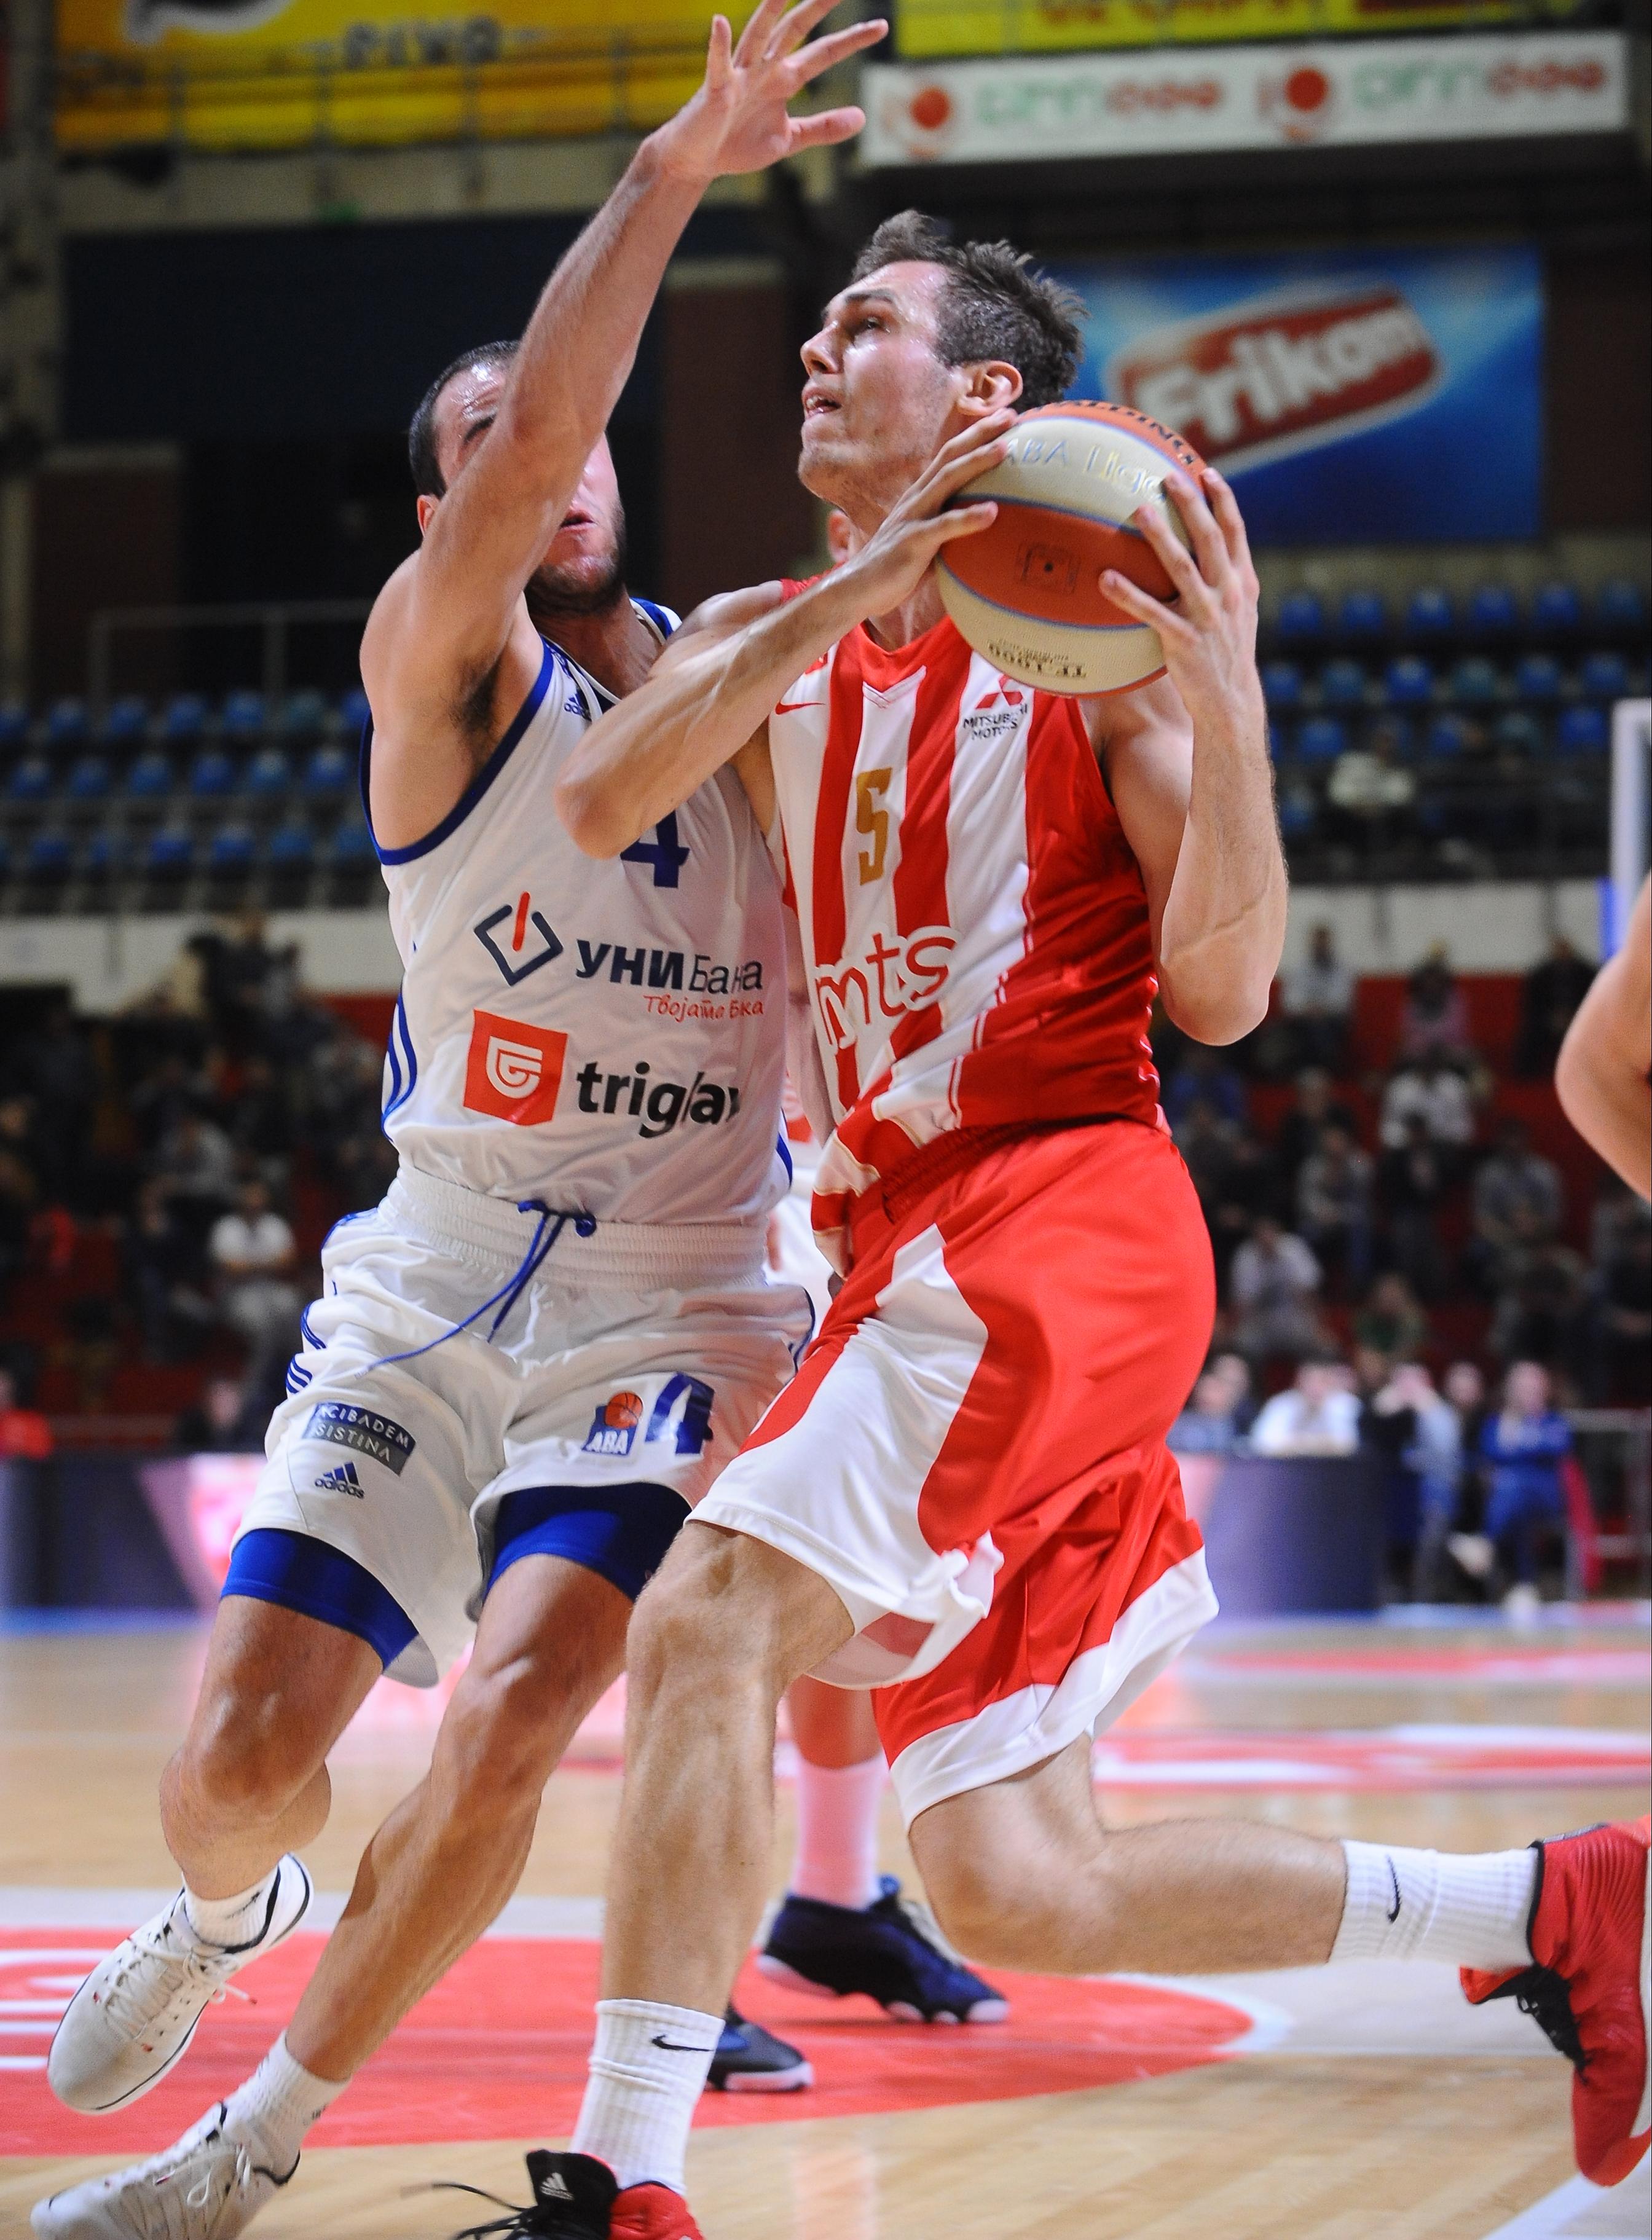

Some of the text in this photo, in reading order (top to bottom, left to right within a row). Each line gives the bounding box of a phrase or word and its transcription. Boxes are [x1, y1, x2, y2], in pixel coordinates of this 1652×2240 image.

[855, 766, 892, 886] 5
[815, 932, 958, 1046] mts
[315, 1423, 390, 1463] SISTINA
